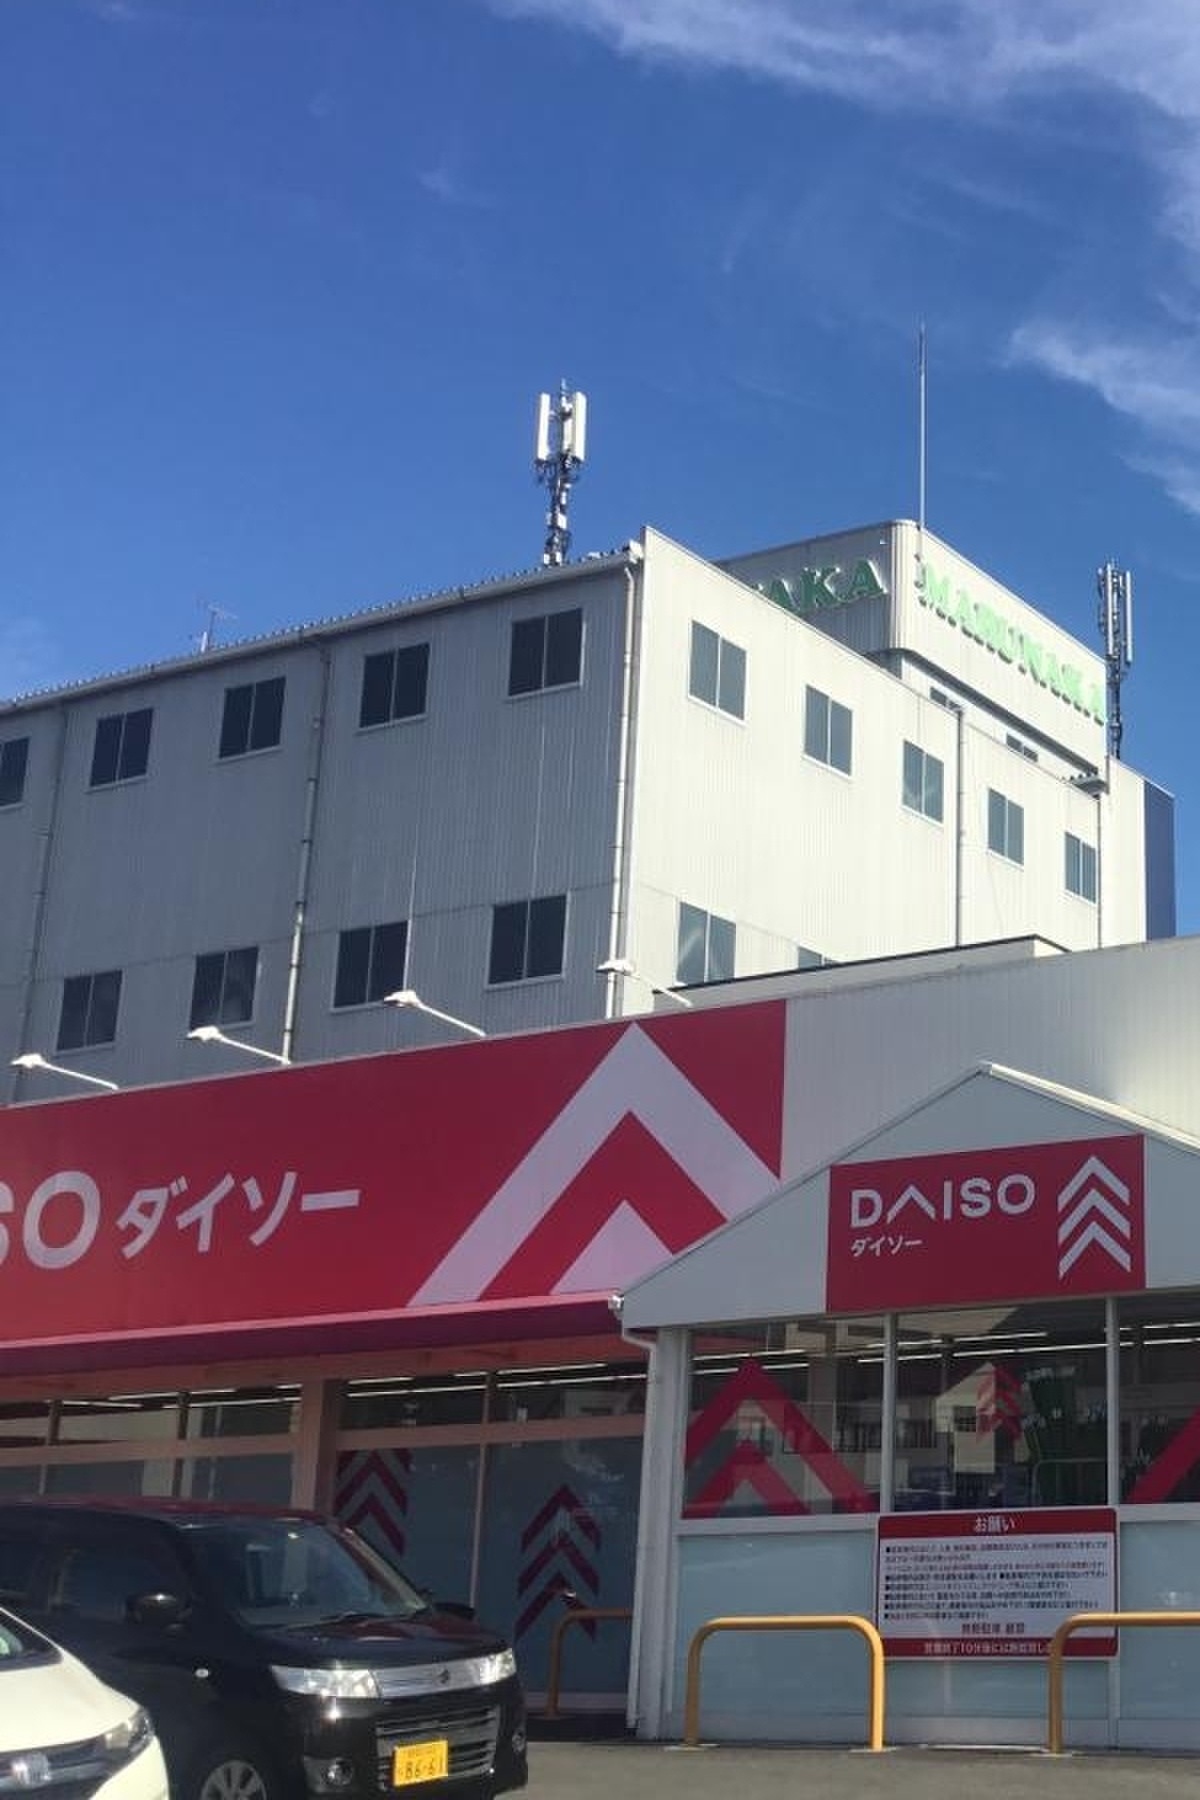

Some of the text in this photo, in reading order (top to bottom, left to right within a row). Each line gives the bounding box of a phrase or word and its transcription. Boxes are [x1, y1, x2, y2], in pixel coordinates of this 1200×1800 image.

[752, 556, 888, 616] AKA
[0, 1170, 101, 1270] O
[115, 1170, 362, 1259] ダイソー
[850, 1172, 1036, 1229] DAISO
[851, 1235, 923, 1258] ダイソー
[974, 1515, 1016, 1533] お願い
